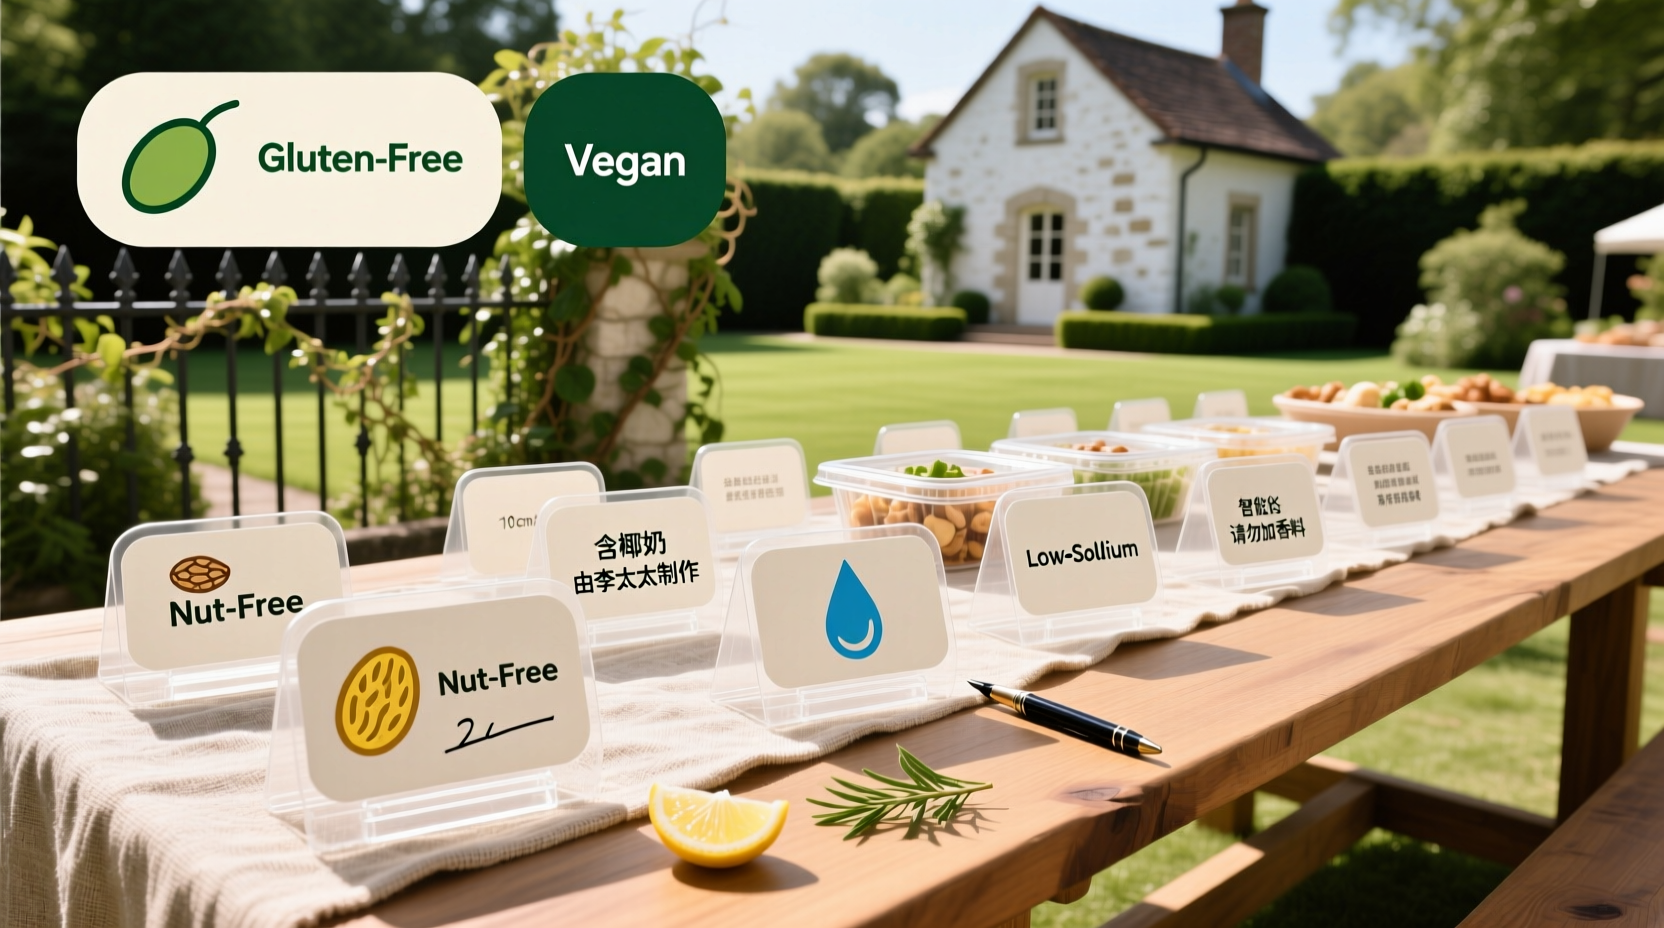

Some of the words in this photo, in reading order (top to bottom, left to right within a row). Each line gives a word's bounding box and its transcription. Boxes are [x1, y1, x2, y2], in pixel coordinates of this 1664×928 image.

[594, 530, 667, 561] 含椰奶
[573, 559, 700, 595] 由李太太制作
[169, 593, 304, 627] Nut-Free
[438, 662, 559, 697] Nut-Free
